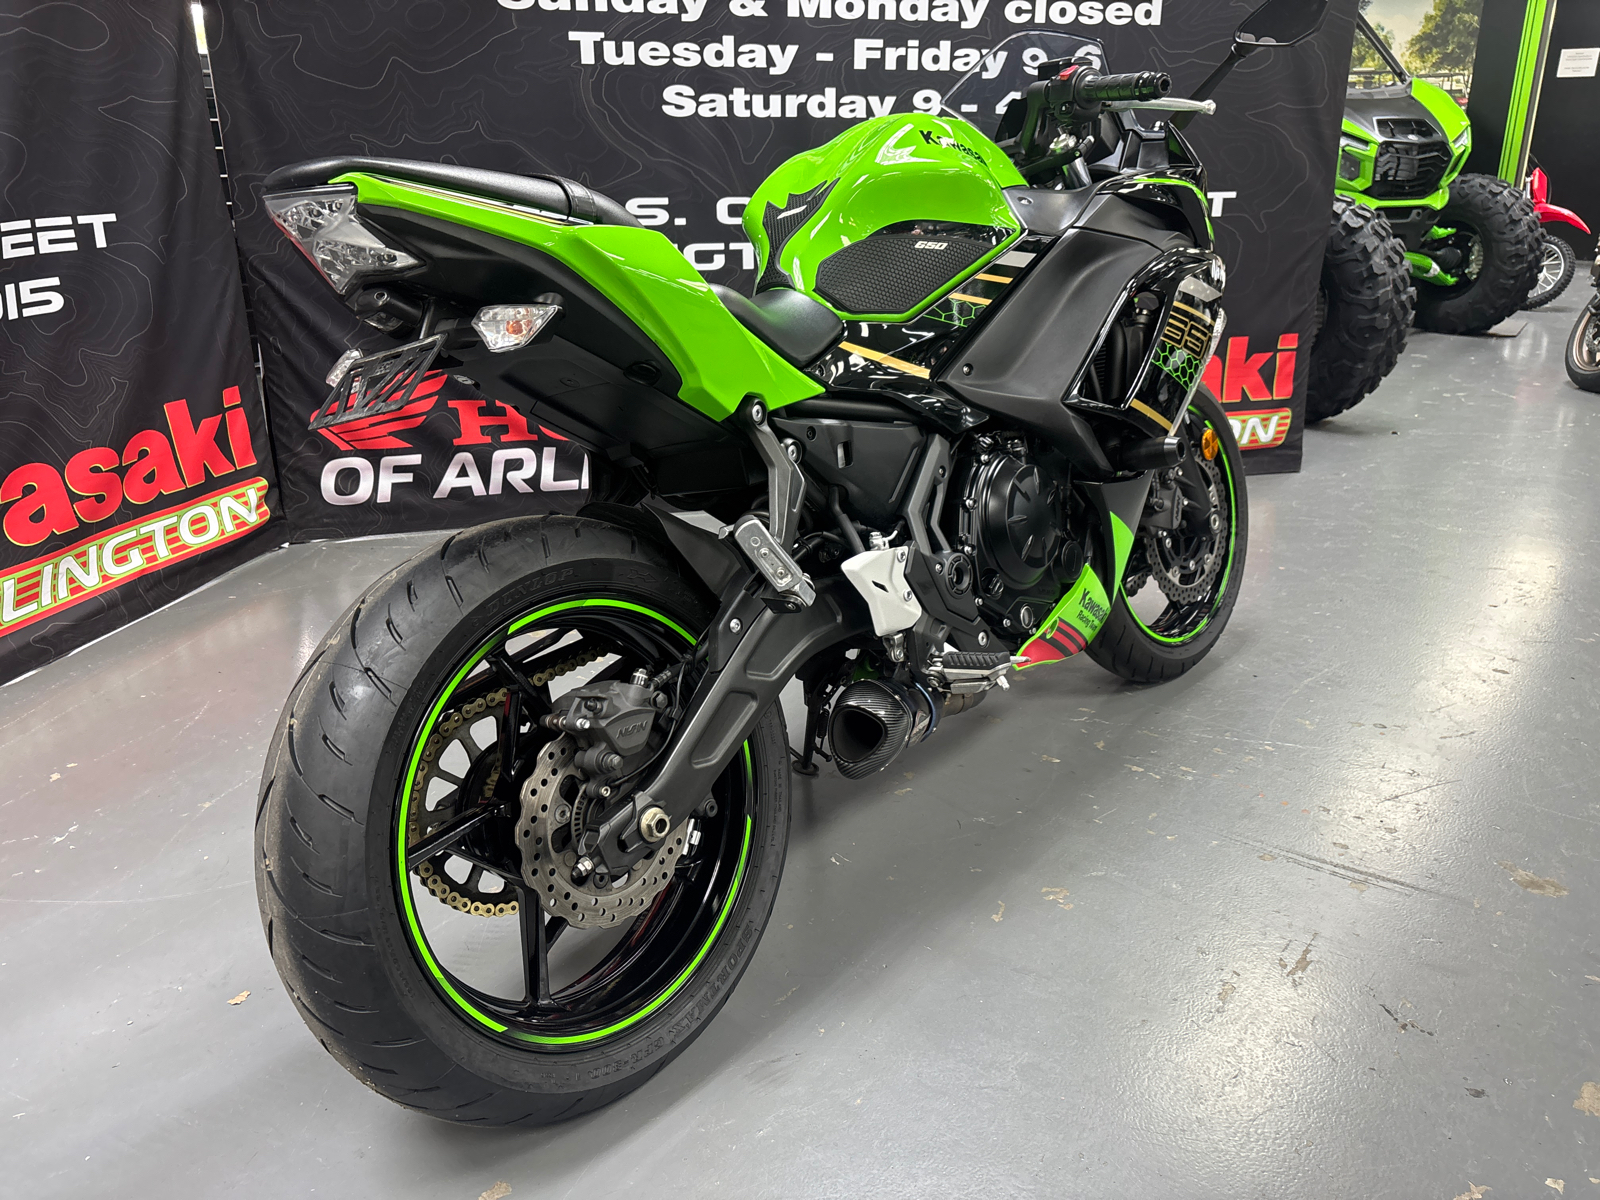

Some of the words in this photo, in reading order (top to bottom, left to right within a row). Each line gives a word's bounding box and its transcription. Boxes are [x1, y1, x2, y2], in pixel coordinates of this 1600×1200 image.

[787, 0, 988, 29] Monday
[1004, 0, 1162, 26] closed
[568, 31, 799, 75] Tuesday
[854, 38, 1008, 79] Friday
[661, 84, 897, 119] Saturday
[912, 89, 942, 119] 9
[0, 213, 117, 260] EET
[673, 242, 754, 271] GT
[0, 276, 65, 320] 15
[1160, 311, 1212, 360] 65
[0, 385, 257, 547] asaki
[320, 450, 422, 506] OF
[1, 487, 260, 624] LINGTON
[486, 567, 574, 618] DUNLOP
